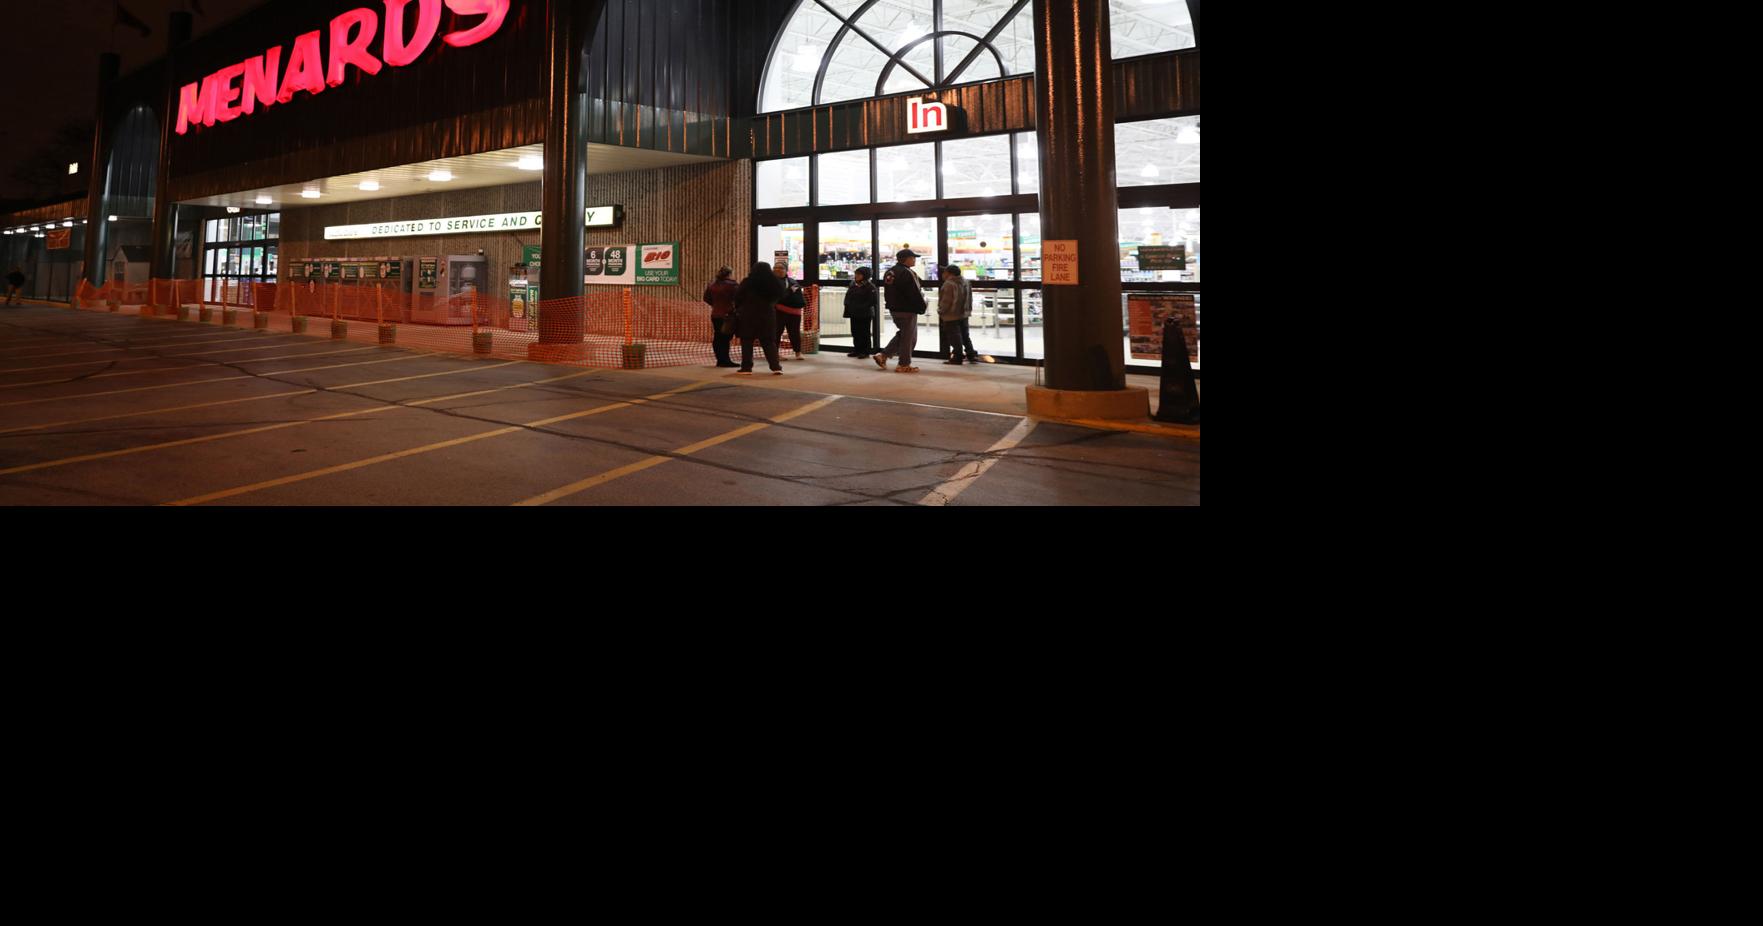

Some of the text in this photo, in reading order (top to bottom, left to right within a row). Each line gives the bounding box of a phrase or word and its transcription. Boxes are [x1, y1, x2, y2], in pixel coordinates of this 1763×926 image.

[912, 102, 942, 129] In
[372, 222, 424, 234] DEDICATED
[429, 221, 442, 231] TO
[447, 218, 495, 230] SERVICE
[502, 216, 527, 227] AND
[1054, 244, 1066, 252] NO
[590, 250, 596, 259] 6
[610, 249, 621, 259] 48
[1044, 253, 1076, 262] PARKING
[1052, 263, 1069, 272] FIRE
[1051, 273, 1071, 281] LANE
